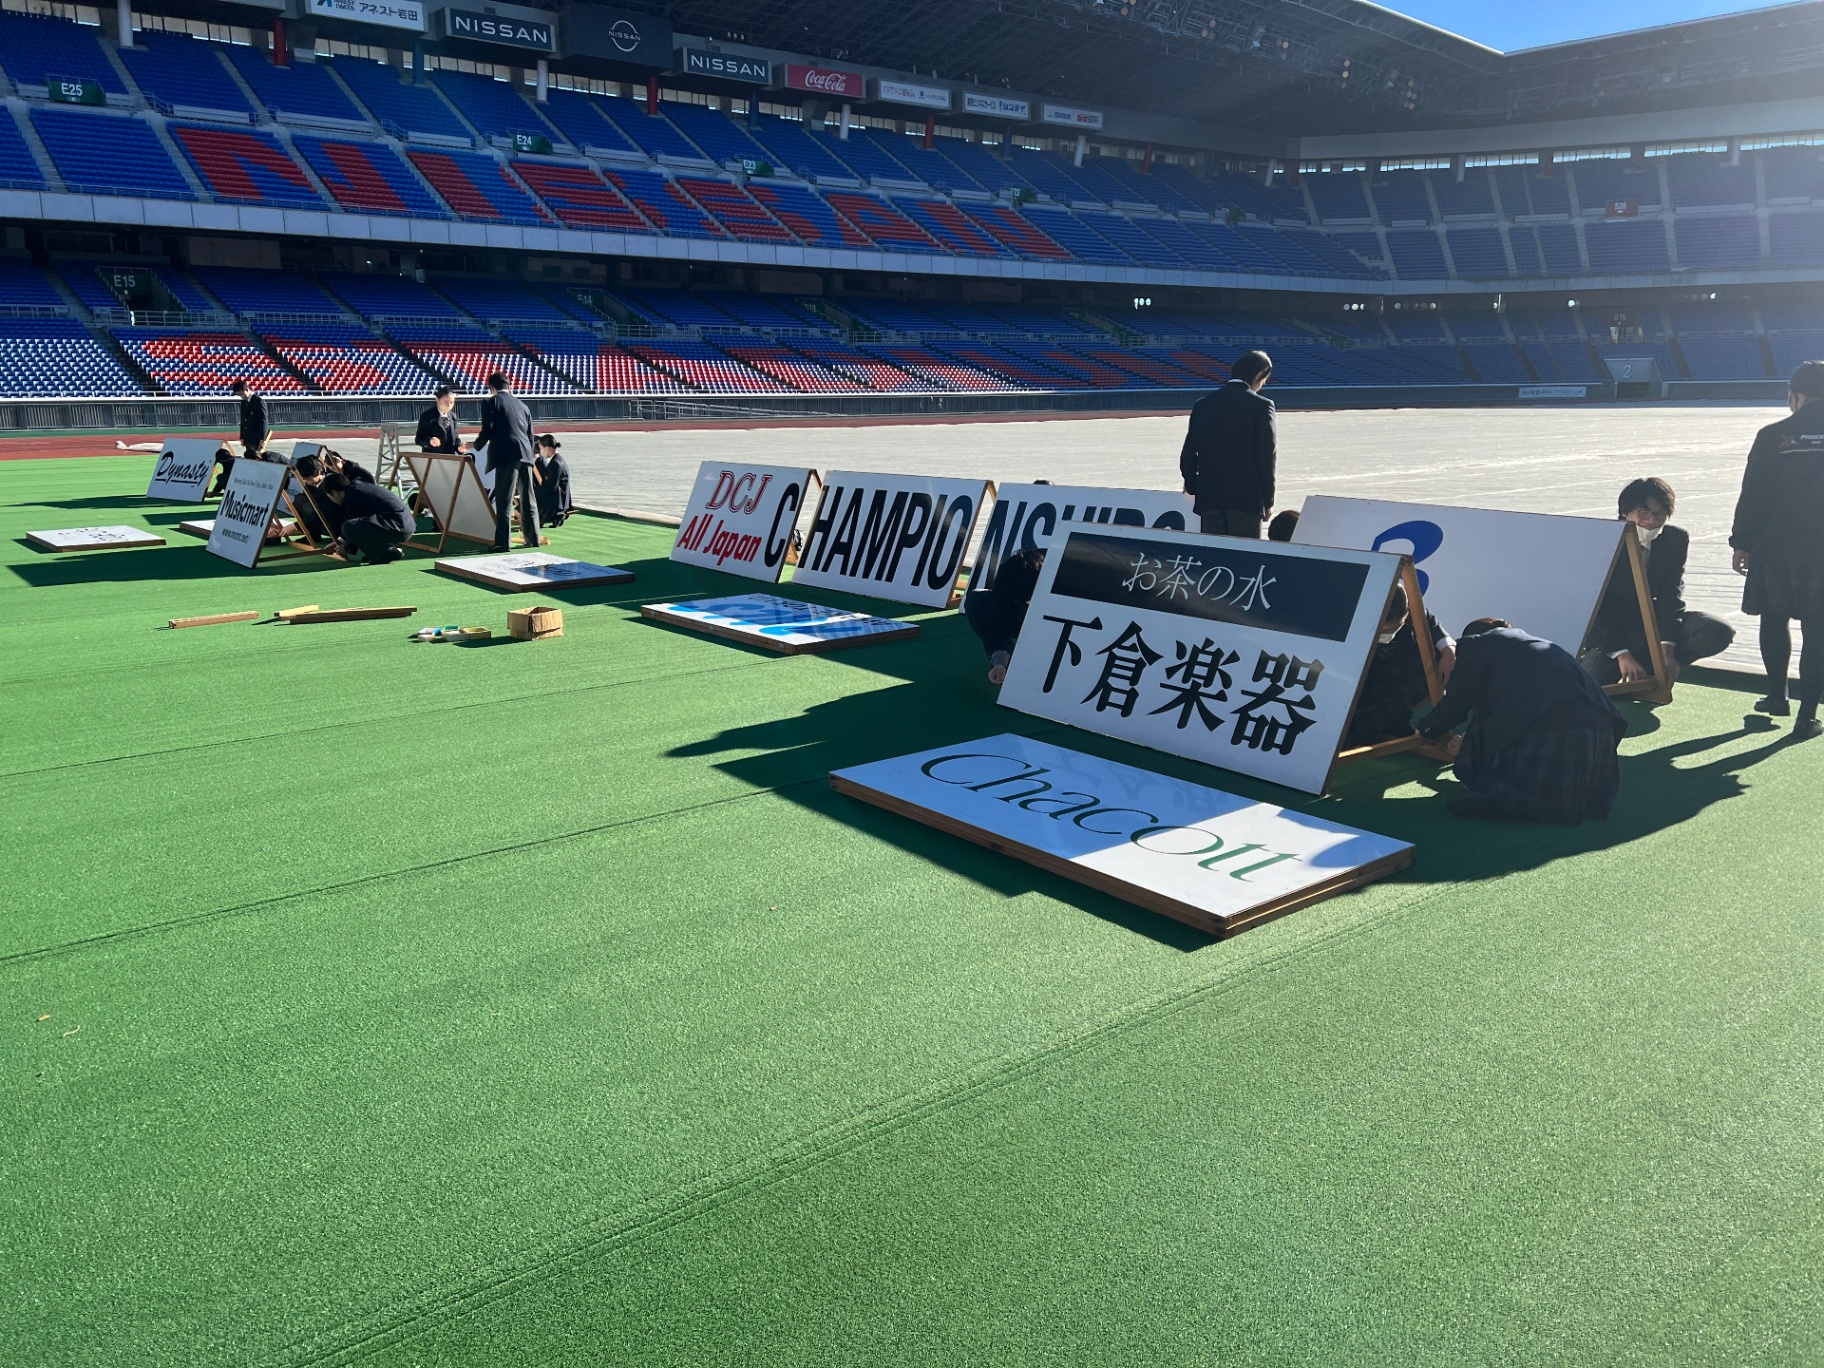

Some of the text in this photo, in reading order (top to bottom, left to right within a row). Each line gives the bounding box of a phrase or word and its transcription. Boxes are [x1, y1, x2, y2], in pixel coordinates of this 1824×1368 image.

[335, 3, 355, 11] IWATA
[359, 2, 418, 21] アネスト岩田
[455, 16, 548, 44] NISSAN
[608, 29, 641, 41] NISSAN
[690, 54, 766, 77] NISSAN
[61, 82, 83, 96] E25
[516, 134, 532, 146] E24
[113, 274, 136, 288] E15
[1622, 364, 1633, 379] 2
[156, 450, 210, 487] Dynasty
[705, 470, 773, 515] DCJ
[219, 488, 270, 529] Musicmart
[676, 513, 763, 566] All Japan
[764, 482, 800, 568] C
[797, 485, 973, 591] HAMPIO
[1121, 551, 1278, 612] お茶の水
[1041, 614, 1326, 756] 下倉楽器
[920, 752, 1304, 884] Chacott
